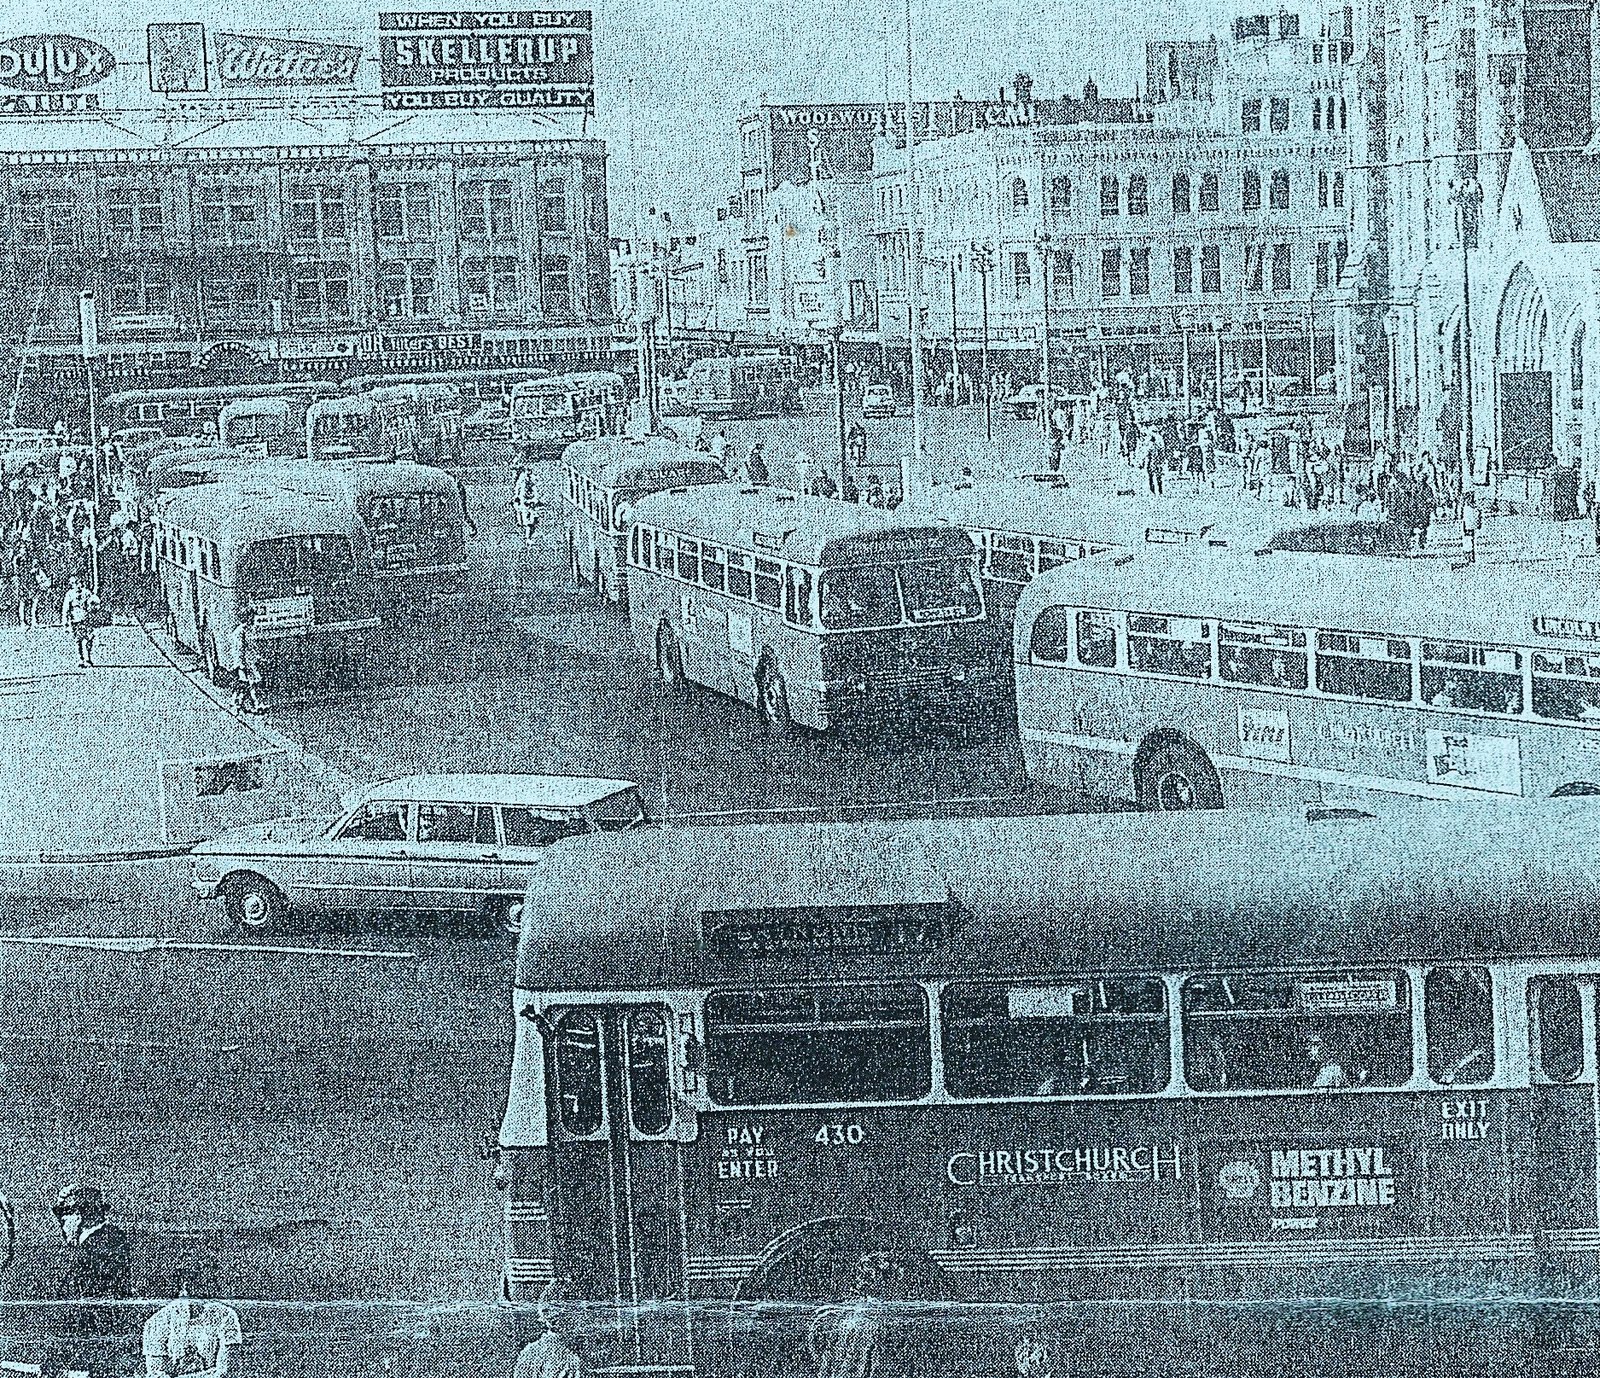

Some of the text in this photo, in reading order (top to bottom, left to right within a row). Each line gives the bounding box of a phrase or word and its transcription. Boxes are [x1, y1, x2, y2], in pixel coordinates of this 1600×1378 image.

[396, 12, 576, 28] WHEN YOU BUY
[396, 37, 578, 66] SKELLERUP
[431, 67, 548, 82] PRODUCTS
[385, 91, 592, 108] YOU BUY QUALITY
[1442, 1100, 1488, 1119] EXIT
[727, 1125, 764, 1145] PAY
[815, 1124, 865, 1146] 430
[1442, 1121, 1490, 1139] ONLY
[718, 1160, 779, 1179] ENTER
[947, 1145, 1182, 1186] CHRISTCHURCH
[1271, 1147, 1392, 1177] METHYL
[1269, 1178, 1395, 1207] BENZINE
